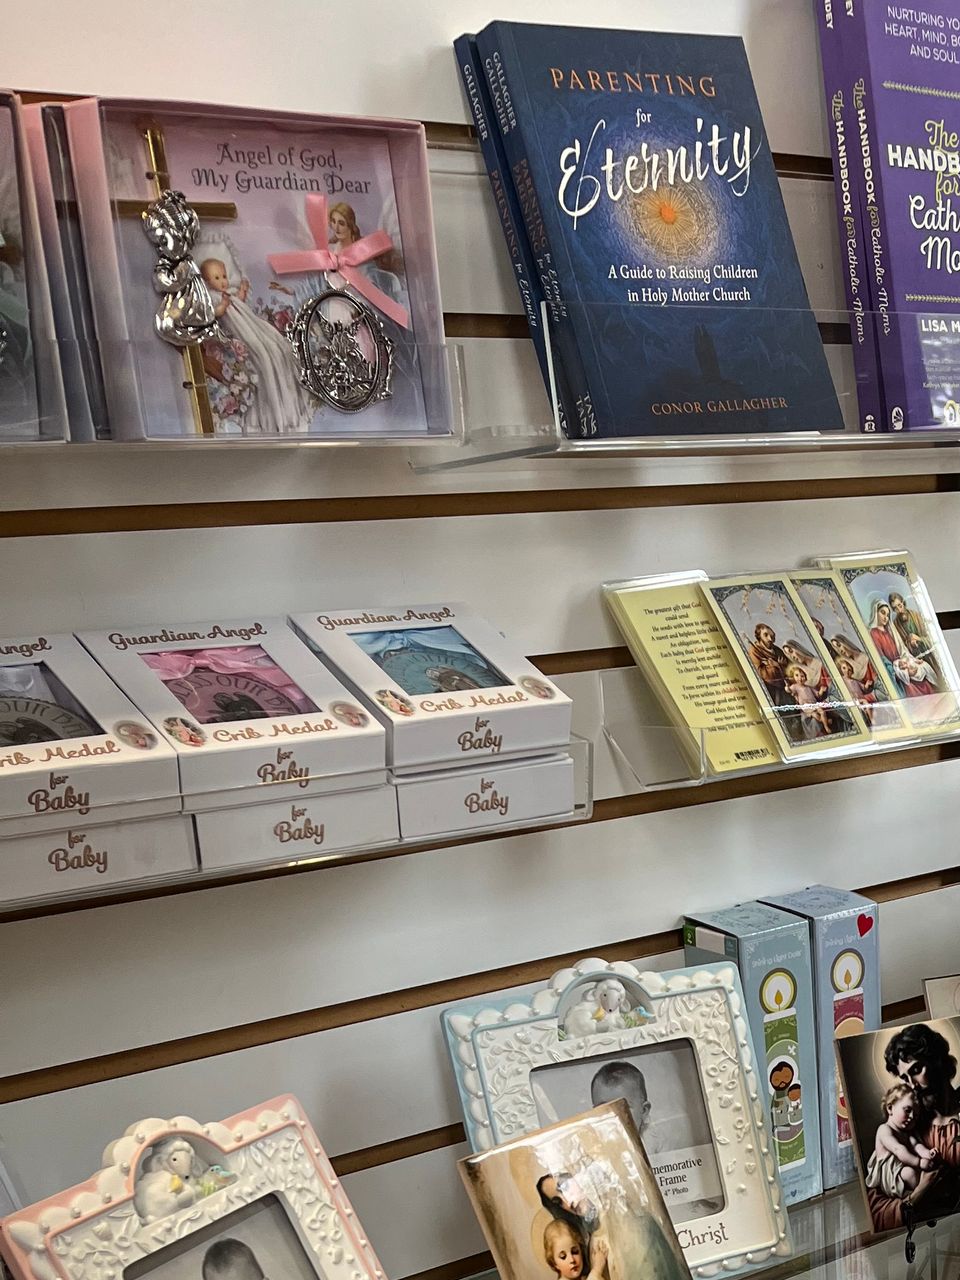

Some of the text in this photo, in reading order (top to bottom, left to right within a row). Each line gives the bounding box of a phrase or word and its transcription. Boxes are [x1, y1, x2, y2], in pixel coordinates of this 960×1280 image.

[887, 6, 946, 28] NURTURING
[884, 23, 919, 43] HEART,
[921, 29, 949, 47] MIND,
[910, 44, 960, 65] AND SOUL
[550, 66, 718, 97] PARENTING
[635, 108, 652, 128] for
[925, 119, 960, 156] The
[217, 143, 343, 171] Angel of God,
[191, 167, 371, 195] My Guardian Dear
[558, 118, 762, 230] Eternity
[608, 265, 758, 284] A Guide to Raising Children
[628, 287, 751, 307] in Holy Mother Church
[921, 319, 949, 335] LISA
[651, 397, 788, 416] CONOR GALLAGHER
[317, 607, 455, 631] Guardian Angel
[108, 622, 267, 650] Guardian Angel
[420, 691, 528, 713] Crib Medal
[212, 718, 338, 743] Crib Medal
[475, 716, 490, 733] for
[39, 740, 121, 763] Medal
[457, 729, 503, 753] Baby
[50, 772, 69, 790] for
[27, 786, 90, 815] Baby
[659, 1174, 687, 1188] Frame
[672, 1186, 689, 1196] Photo
[677, 1222, 729, 1250] Christ
